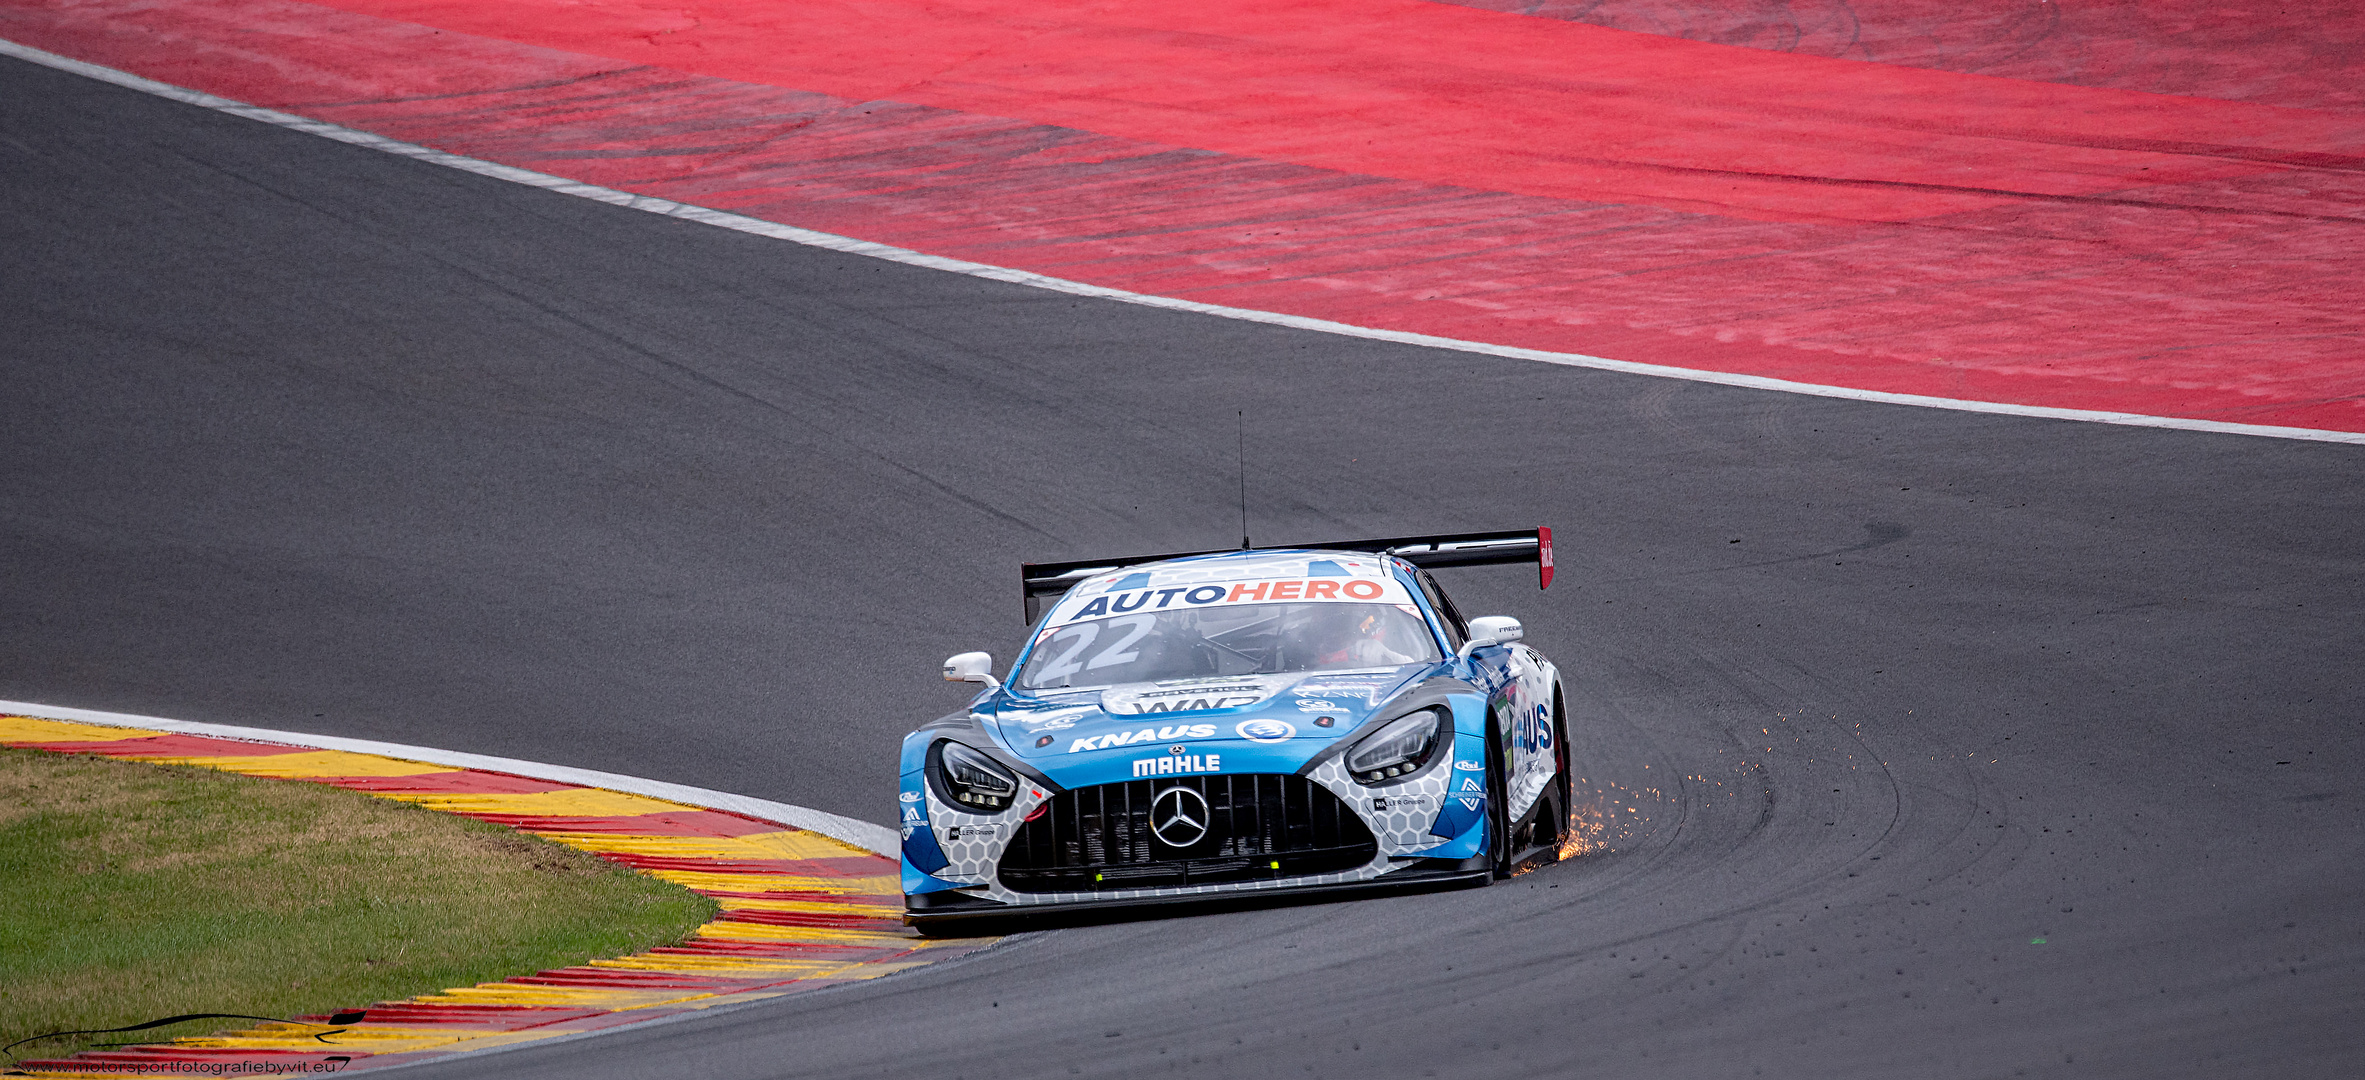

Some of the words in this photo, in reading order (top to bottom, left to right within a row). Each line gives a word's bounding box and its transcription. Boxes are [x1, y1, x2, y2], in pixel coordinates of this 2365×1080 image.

[1069, 580, 1384, 621] AUTOHERO
[1032, 613, 1157, 685] 22
[1069, 724, 1217, 753] KNAUS
[1133, 754, 1220, 777] MAHLE
